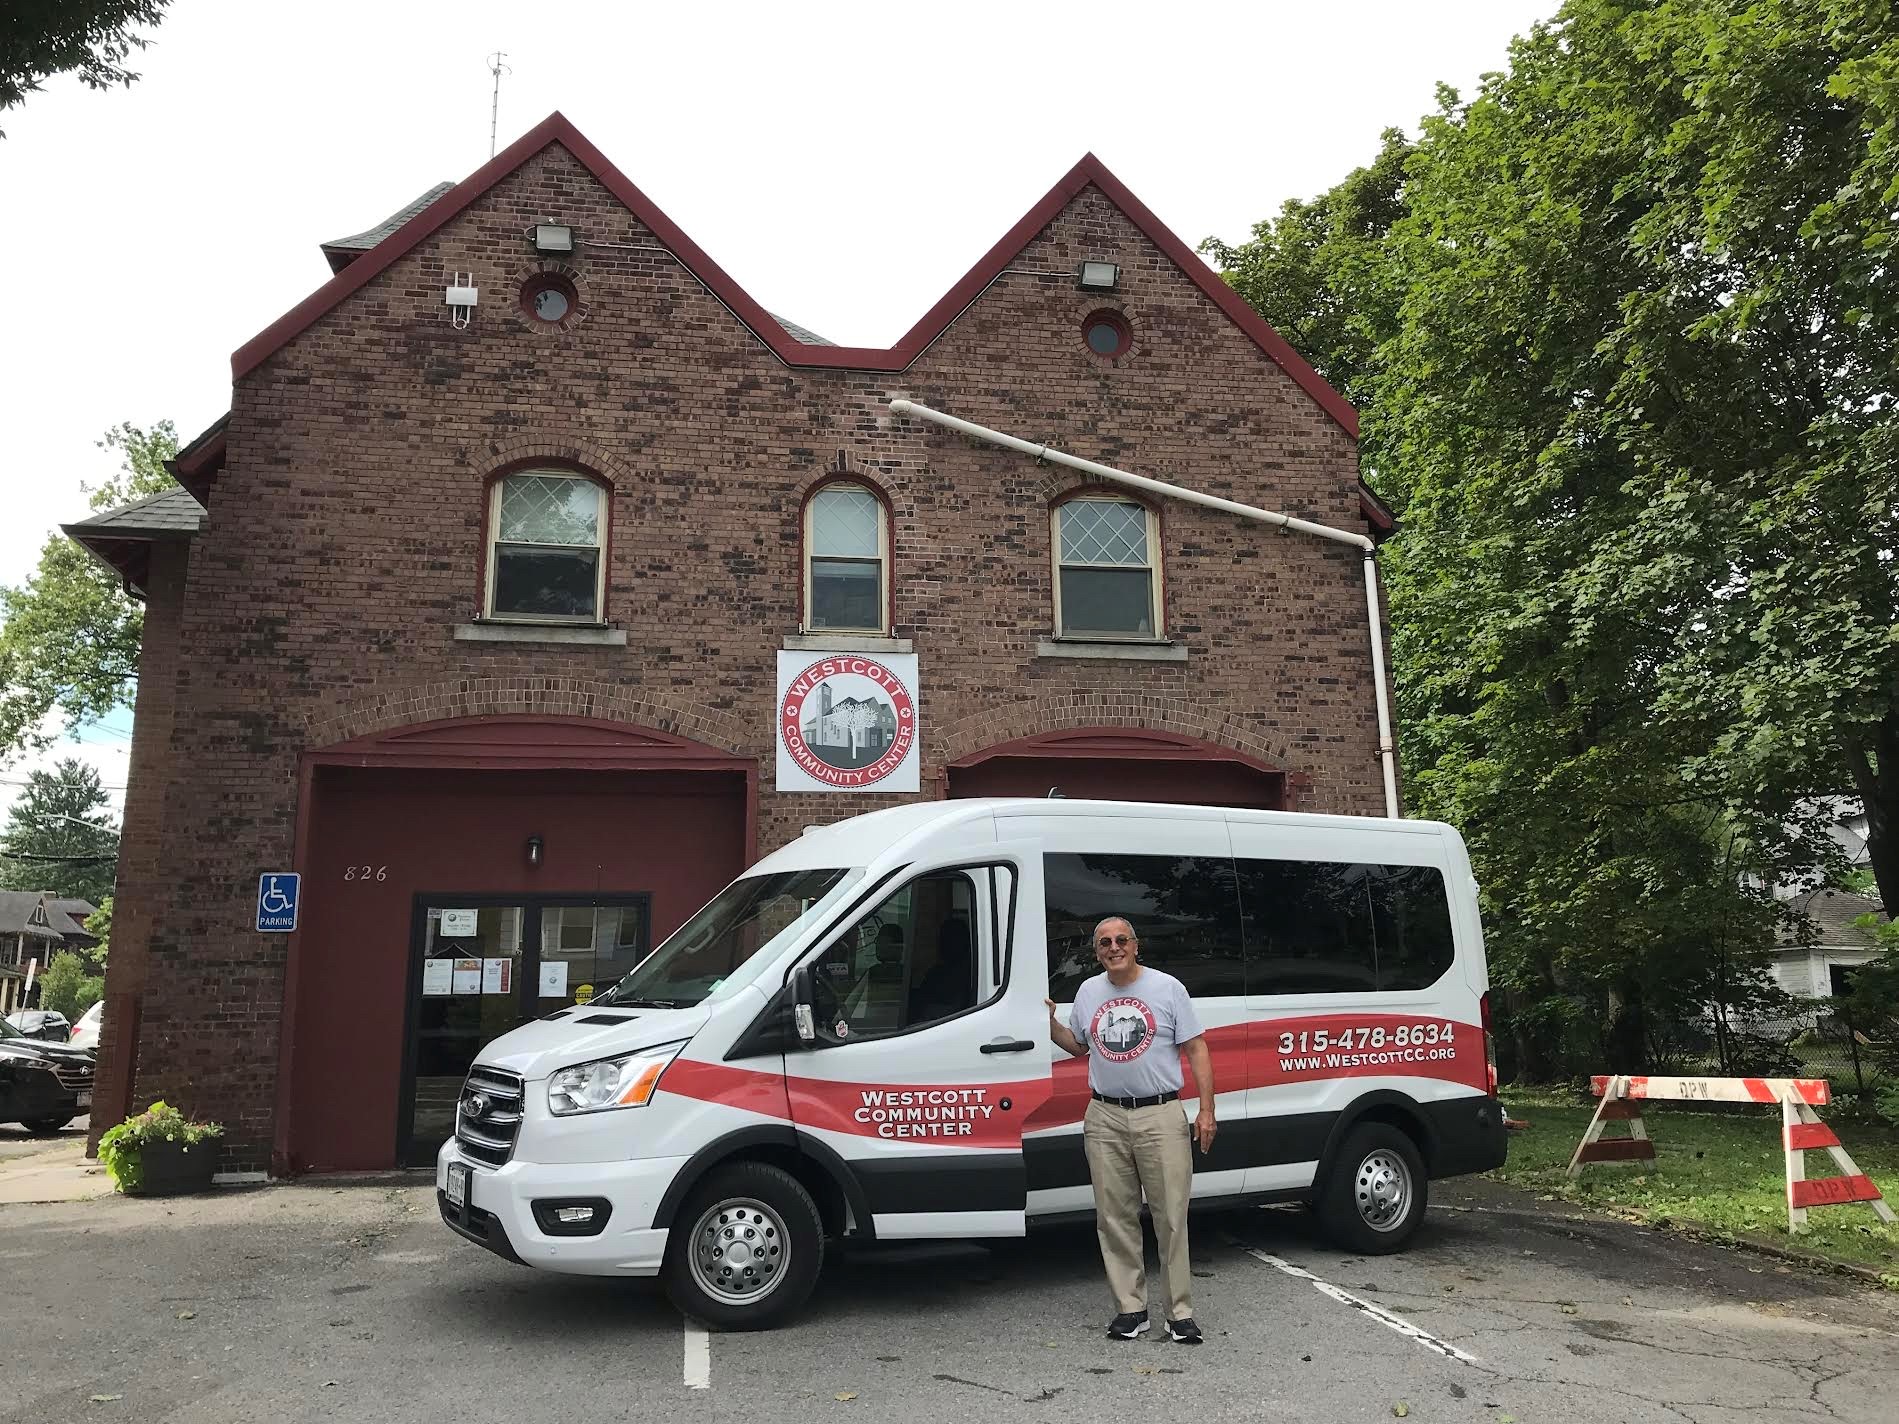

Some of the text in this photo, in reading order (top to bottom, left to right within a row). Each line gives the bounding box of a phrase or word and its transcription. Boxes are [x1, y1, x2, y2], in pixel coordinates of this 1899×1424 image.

[790, 659, 905, 698] WESTCOTT
[786, 725, 911, 783] COMMUNITY CENTER
[344, 865, 387, 882] 826
[259, 917, 293, 926] PARKING
[1095, 998, 1151, 1020] WESTCOTT
[1092, 1028, 1155, 1061] COMMUNITY CENTER
[1277, 1022, 1455, 1055] 315-478-8634
[860, 1089, 987, 1107] WESTCOTT
[854, 1105, 994, 1123] COMMUNITY
[877, 1122, 973, 1138] CENTER
